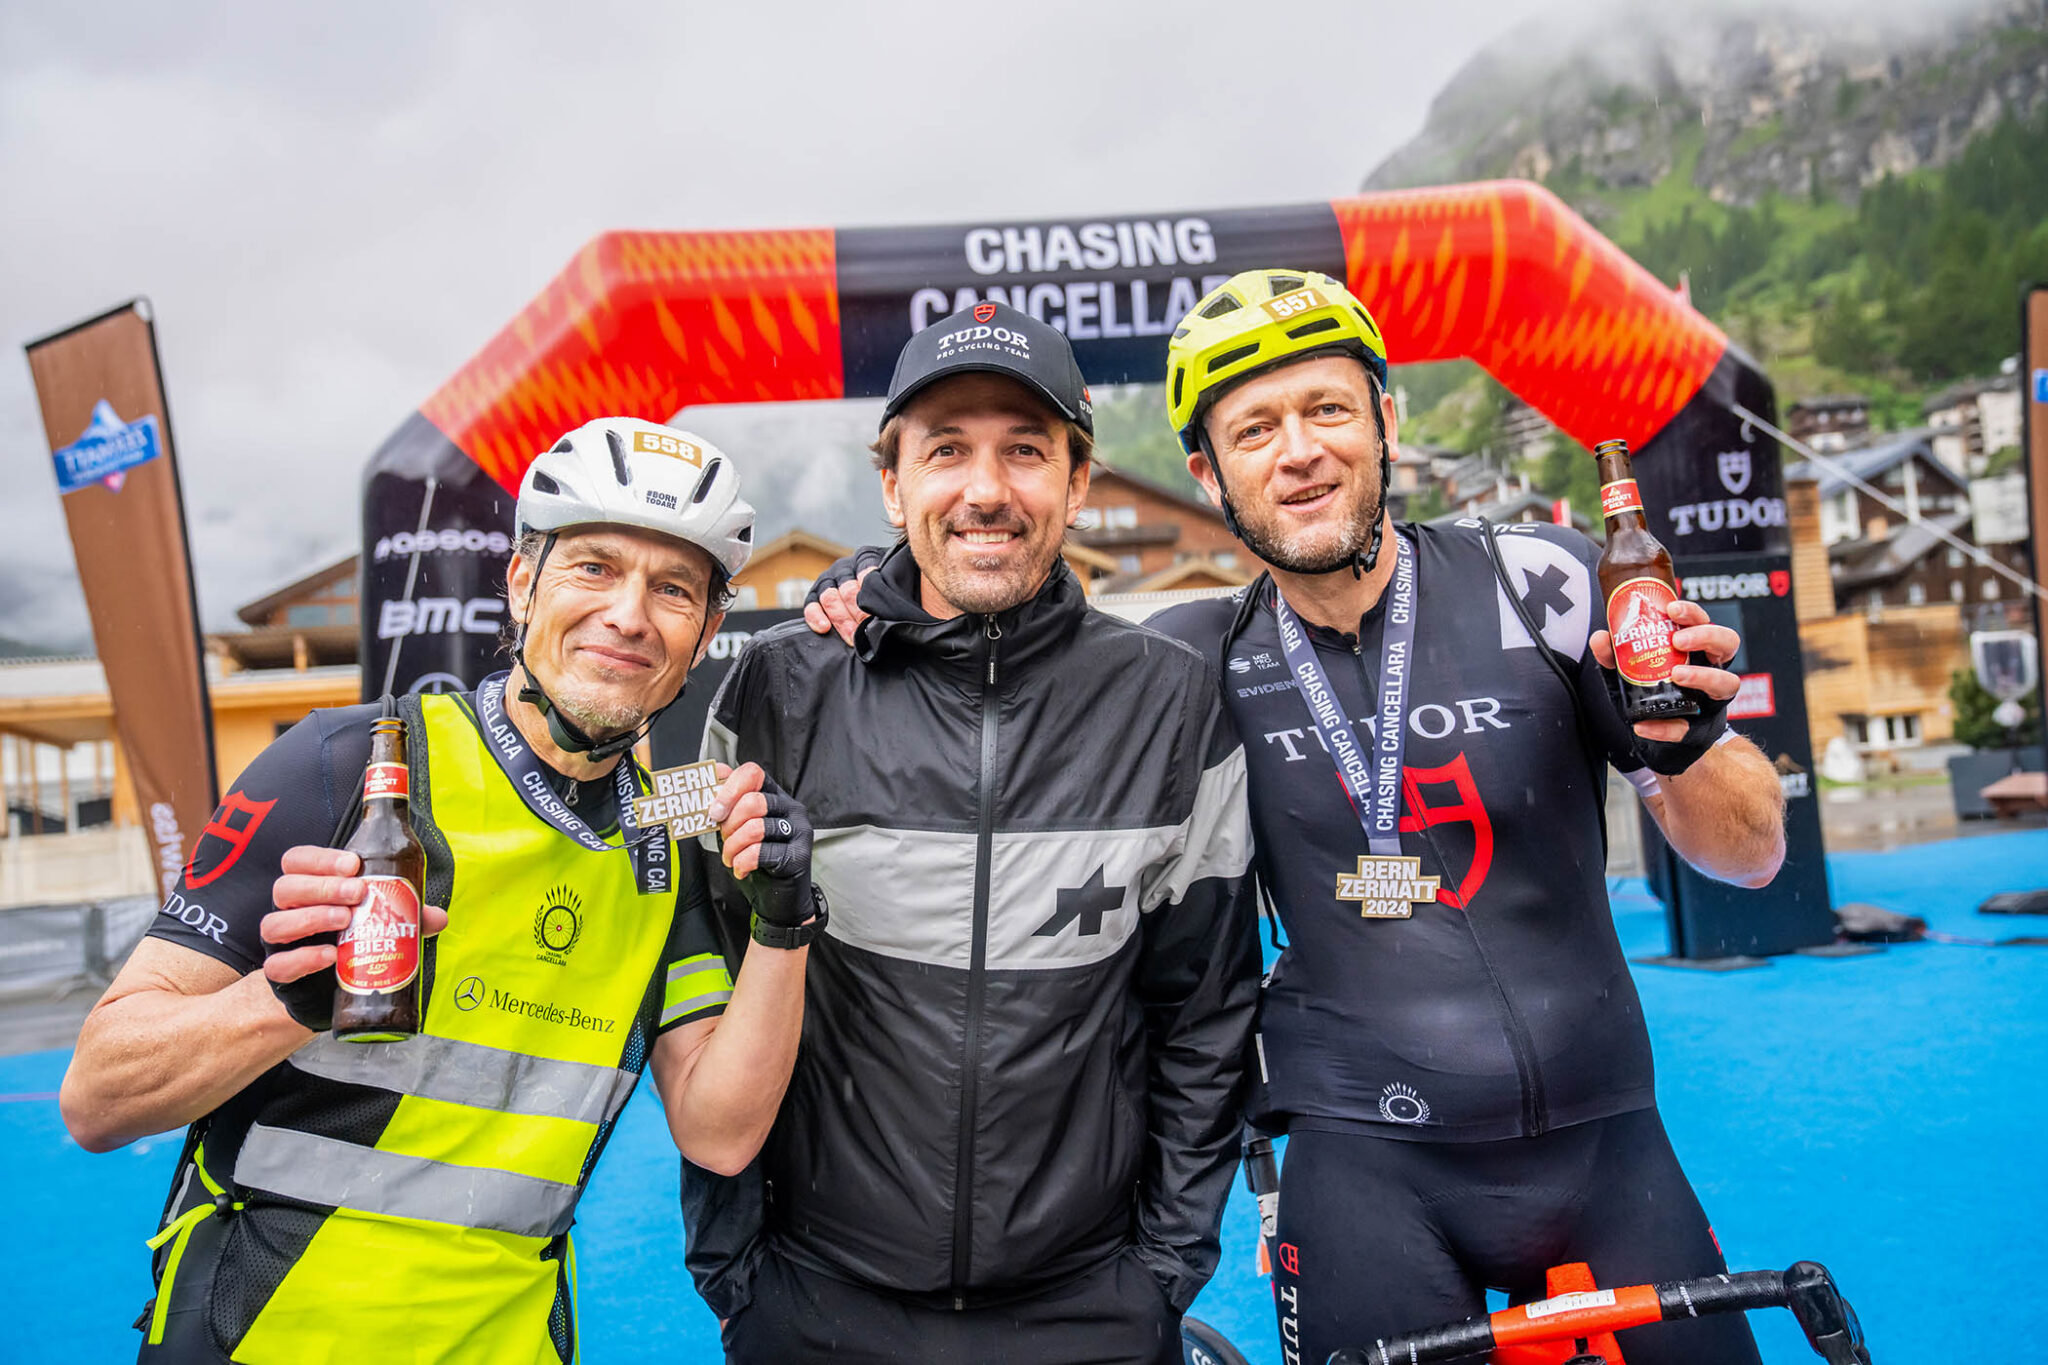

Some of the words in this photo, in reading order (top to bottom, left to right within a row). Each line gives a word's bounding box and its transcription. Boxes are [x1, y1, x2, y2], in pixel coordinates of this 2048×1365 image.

[965, 218, 1217, 275] CHASING
[1270, 290, 1318, 316] 557
[936, 349, 954, 360] PRO
[958, 342, 1000, 352] CYCLING
[1004, 346, 1030, 360] TEAM
[938, 326, 1030, 350] TUDOR
[643, 434, 695, 460] 558
[646, 490, 677, 503] #BORN
[1668, 497, 1787, 536] TUDOR
[1391, 557, 1413, 624] CHASING
[1681, 572, 1771, 600] TUDOR
[378, 596, 505, 640] BMC
[1613, 620, 1680, 647] ZERMAT
[1631, 634, 1670, 653] BIER
[1252, 652, 1269, 660] UCI
[1254, 657, 1272, 666] PRO
[1257, 661, 1280, 670] TEAM
[1297, 661, 1340, 730] CHASING
[1381, 641, 1406, 752] CANCELLARA
[482, 675, 523, 760] ANCELLARA
[522, 771, 583, 831] CHASING
[656, 764, 717, 797] BERN
[639, 785, 724, 823] ZERMA
[1376, 756, 1398, 833] CHASING
[673, 813, 718, 837] 2024
[1361, 860, 1417, 881] BERN
[1339, 879, 1437, 900] ZERMATT
[1365, 900, 1409, 916] 2024
[339, 923, 417, 945] ZERMATT
[353, 938, 397, 956] BIER
[347, 951, 405, 969] Matterhorn
[489, 989, 616, 1034] Mercedes-Benz
